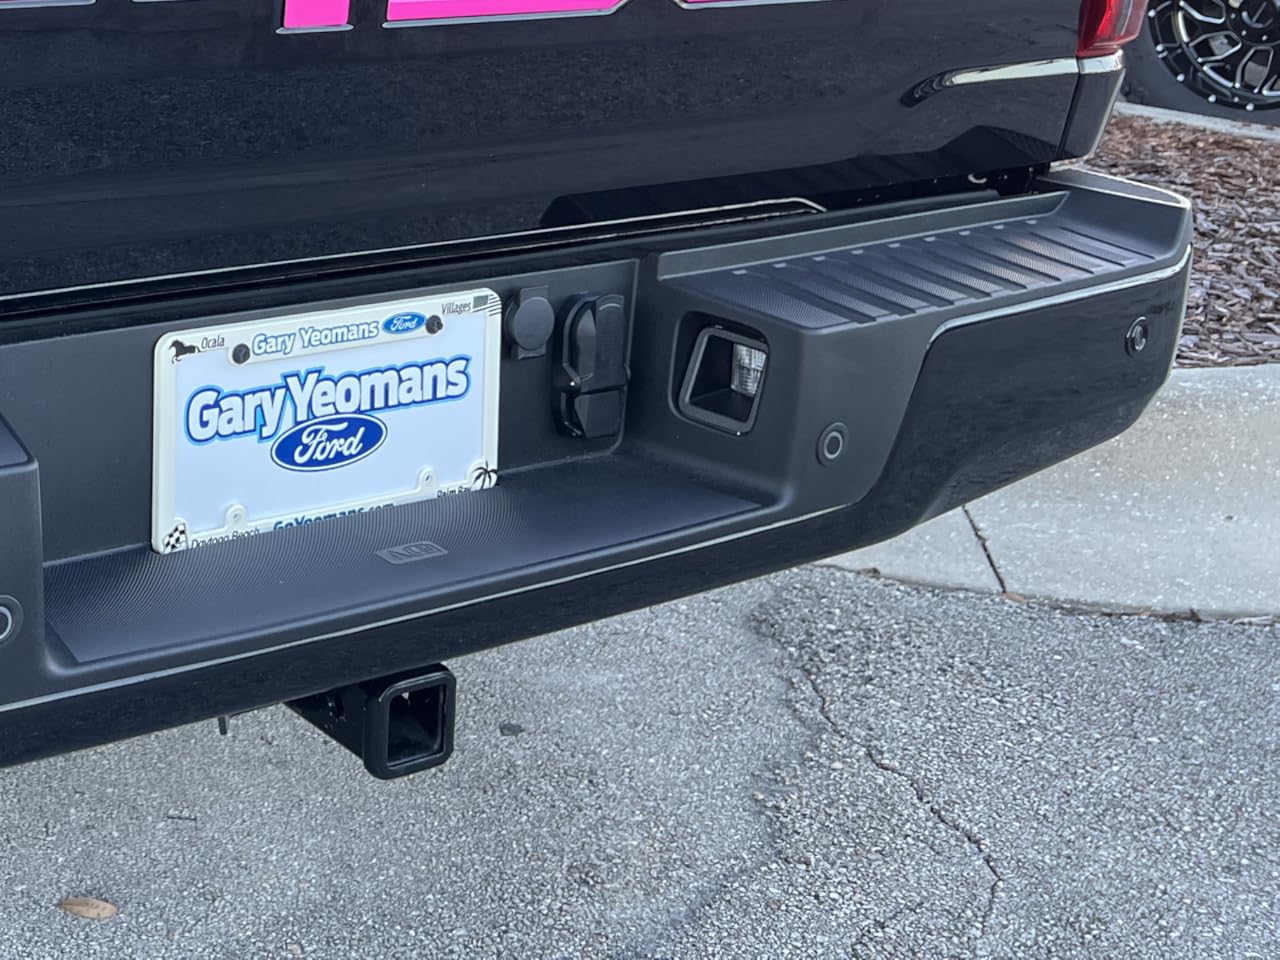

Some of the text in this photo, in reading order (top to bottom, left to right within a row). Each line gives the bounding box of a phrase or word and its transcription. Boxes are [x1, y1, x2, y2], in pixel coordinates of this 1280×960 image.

[441, 301, 472, 315] Villages
[390, 315, 419, 331] Ford
[201, 335, 225, 349] Ocala
[252, 321, 379, 356] Gary Yeomans
[187, 356, 470, 442] Gary Yeomans
[293, 421, 366, 464] Ford
